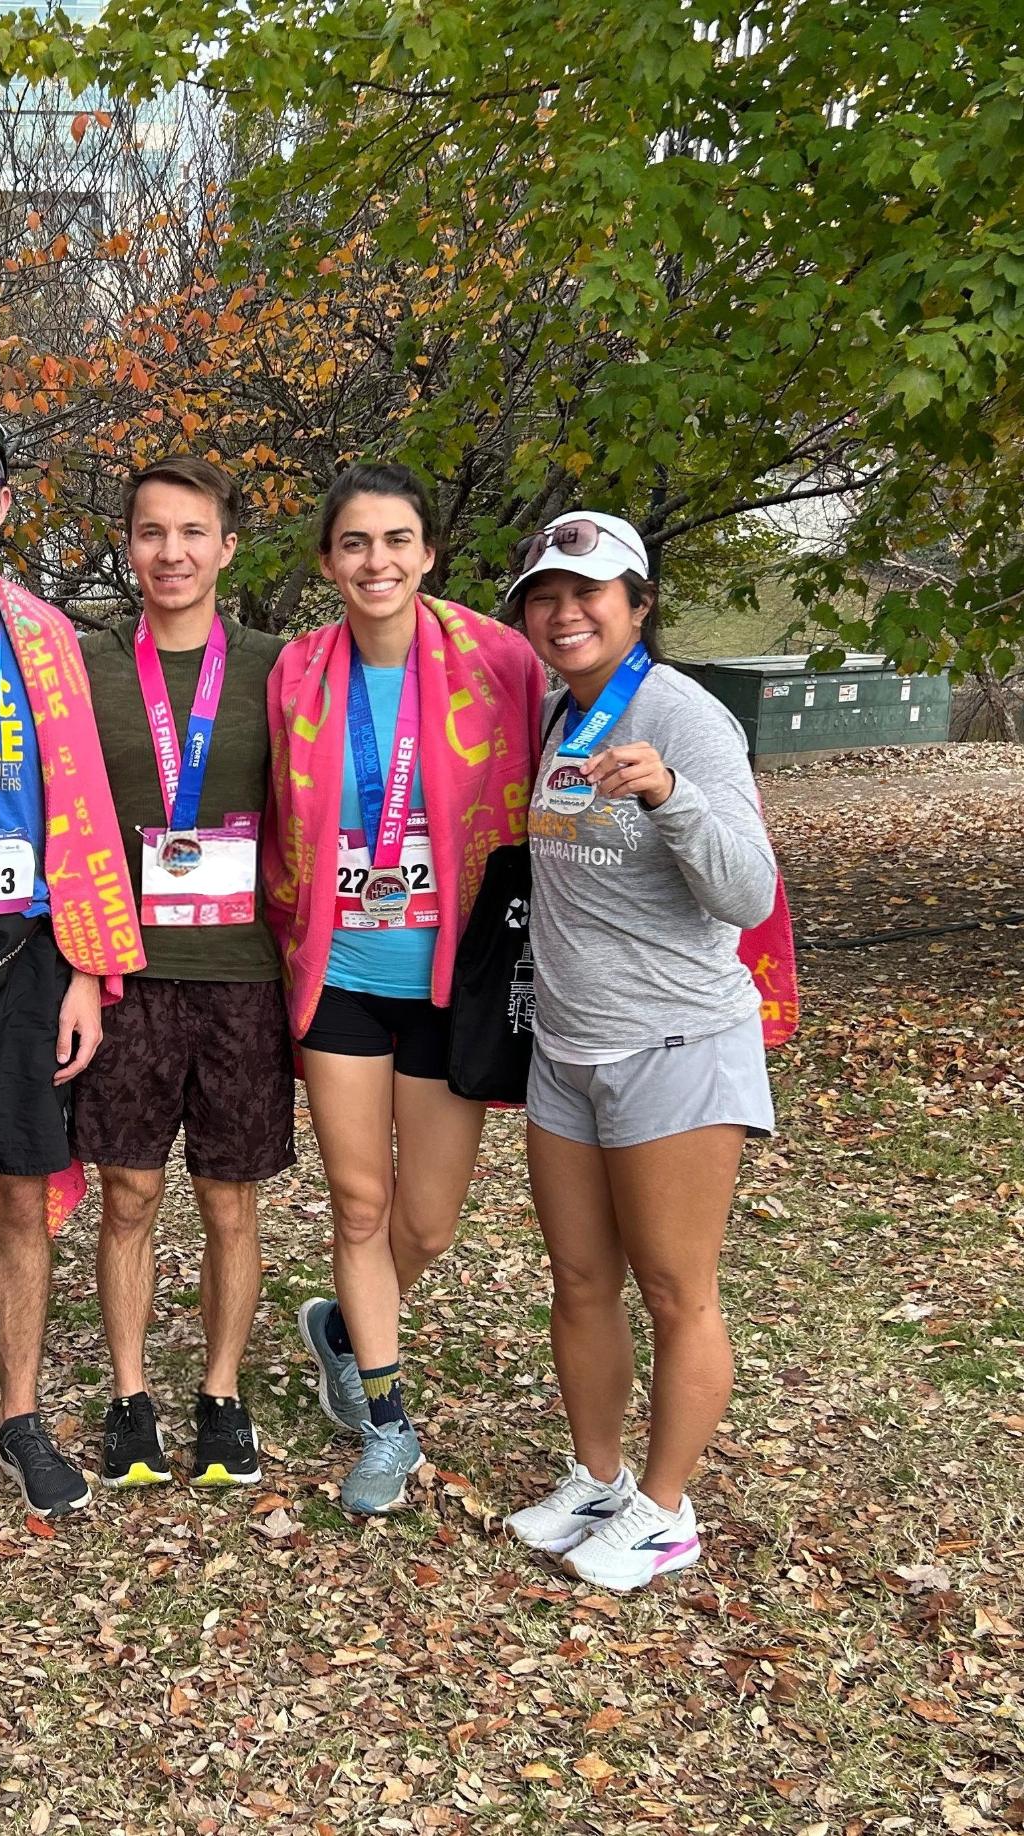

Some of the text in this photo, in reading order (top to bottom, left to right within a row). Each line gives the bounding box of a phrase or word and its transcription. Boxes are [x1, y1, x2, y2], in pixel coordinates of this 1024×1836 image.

[154, 700, 178, 805] 13.1 FINISHER
[193, 741, 205, 768] SPORTS
[383, 736, 414, 846] 13.1 FINISHER
[539, 838, 624, 866] MARATHON
